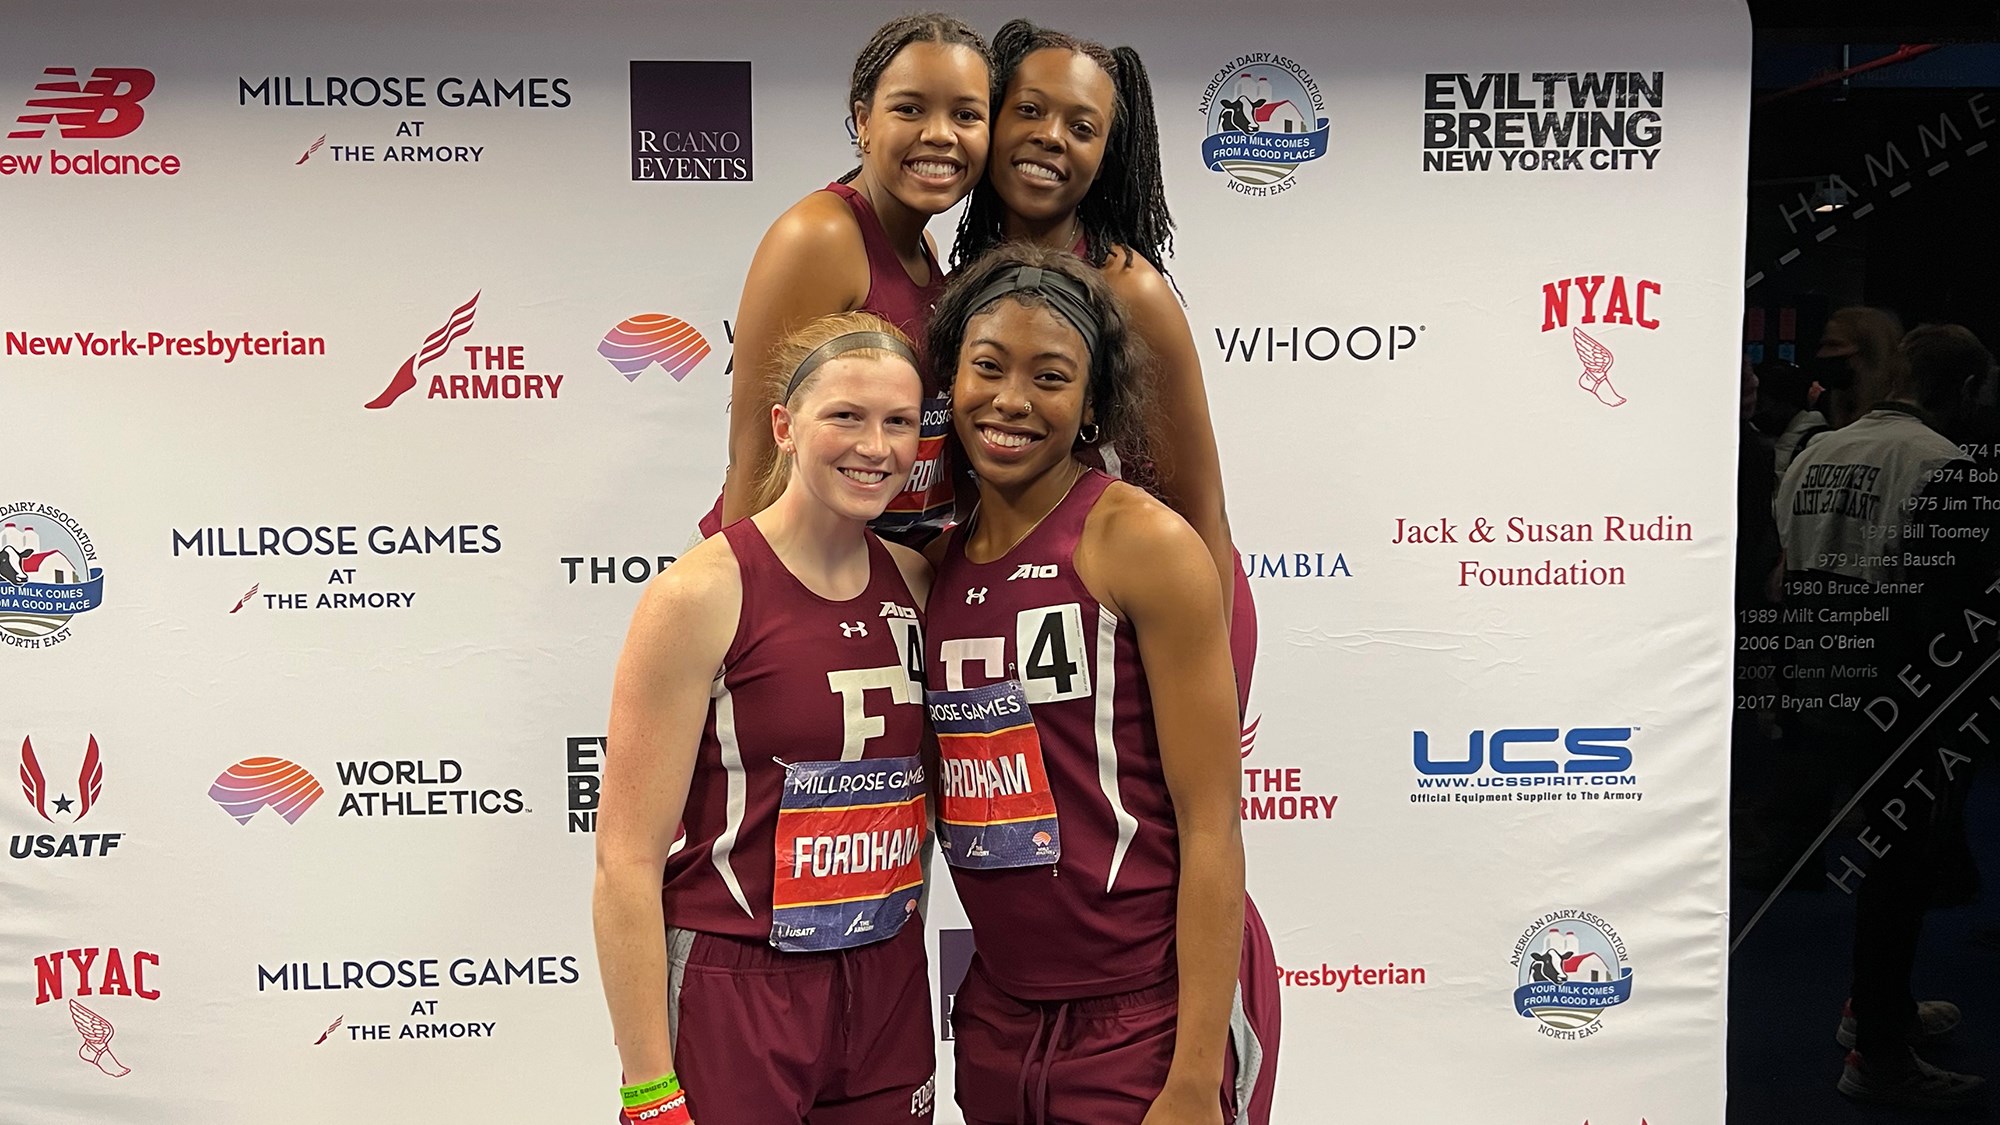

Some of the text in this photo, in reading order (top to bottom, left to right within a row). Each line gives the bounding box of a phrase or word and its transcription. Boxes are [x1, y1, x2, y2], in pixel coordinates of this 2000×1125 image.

[239, 76, 571, 107] MILLROSE GAMES
[1199, 53, 1325, 115] AMERICAN DAIRY ASSOCIATION
[396, 121, 425, 138] AT
[1424, 110, 1662, 149] BREWING
[1219, 135, 1311, 148] YOUR MILK COMES
[0, 149, 181, 175] ew balance
[330, 146, 485, 162] THE ARMORY
[1213, 147, 1316, 160] FROM A GOOD PLACE
[1423, 148, 1661, 172] NEW YORK CITY
[1778, 92, 1998, 235] HAMME
[638, 157, 747, 180] EVENTS
[1227, 175, 1297, 197] NORTH EAST
[1541, 275, 1662, 333] NYAC
[464, 345, 524, 370] THE
[427, 374, 564, 399] ARMORY
[1959, 443, 1989, 458] 974
[1968, 467, 1999, 483] Bob
[1942, 496, 1968, 511] Jim
[36, 503, 97, 561] ASSOCIATION
[172, 524, 502, 557] MILLROSE GAMES
[1392, 515, 1693, 544] Jack & Susan Rudin
[1902, 523, 1925, 539] Bill
[1929, 524, 1990, 543] Toomey
[1817, 552, 1956, 568] 979 James Bausch
[328, 569, 357, 585] AT
[1458, 559, 1626, 587] Foundation
[18, 587, 43, 598] MILK
[45, 588, 84, 598] COMES
[1784, 581, 1925, 595] 1980 Bruce Jenner
[12, 599, 20, 608] A
[21, 599, 54, 611] GOOD
[55, 599, 91, 611] PLACE
[263, 592, 416, 609] THE ARMORY
[1739, 607, 1890, 626] 1989 Milt Campbell
[0, 627, 72, 649] NORTH EAST
[1739, 634, 1875, 650] 2006 Dan O'Brien
[1026, 611, 1078, 694] 4
[1737, 663, 1878, 680] 2007 Glenn Morris
[961, 694, 1021, 720] GAMES
[1737, 693, 1861, 712] 2017 Bryan Clay
[1413, 728, 1633, 775] UCS
[336, 760, 462, 786] WORLD
[793, 771, 886, 795] MILLROSE
[1244, 769, 1301, 792] THE
[1417, 775, 1637, 788] WWW.UCSSPIRIT.COM
[338, 789, 524, 817] ATHLETICS
[1410, 790, 1643, 804] Official Equipment Supplier to The Armory
[9, 833, 122, 859] USATF
[793, 825, 919, 879] FORDHAM
[789, 927, 817, 938] USATF
[1510, 909, 1629, 968] AMERICAN DAIRY ASSOCIATION
[35, 947, 161, 1006] NYAC
[258, 956, 580, 992] MILLROSE GAMES
[1524, 995, 1620, 1006] FROM A GOOD PLACE
[1530, 985, 1615, 996] YOUR MILK COMES
[410, 1001, 439, 1016] AT
[347, 1022, 497, 1040] THE ARMORY
[1537, 1020, 1604, 1041] NORTH EAST
